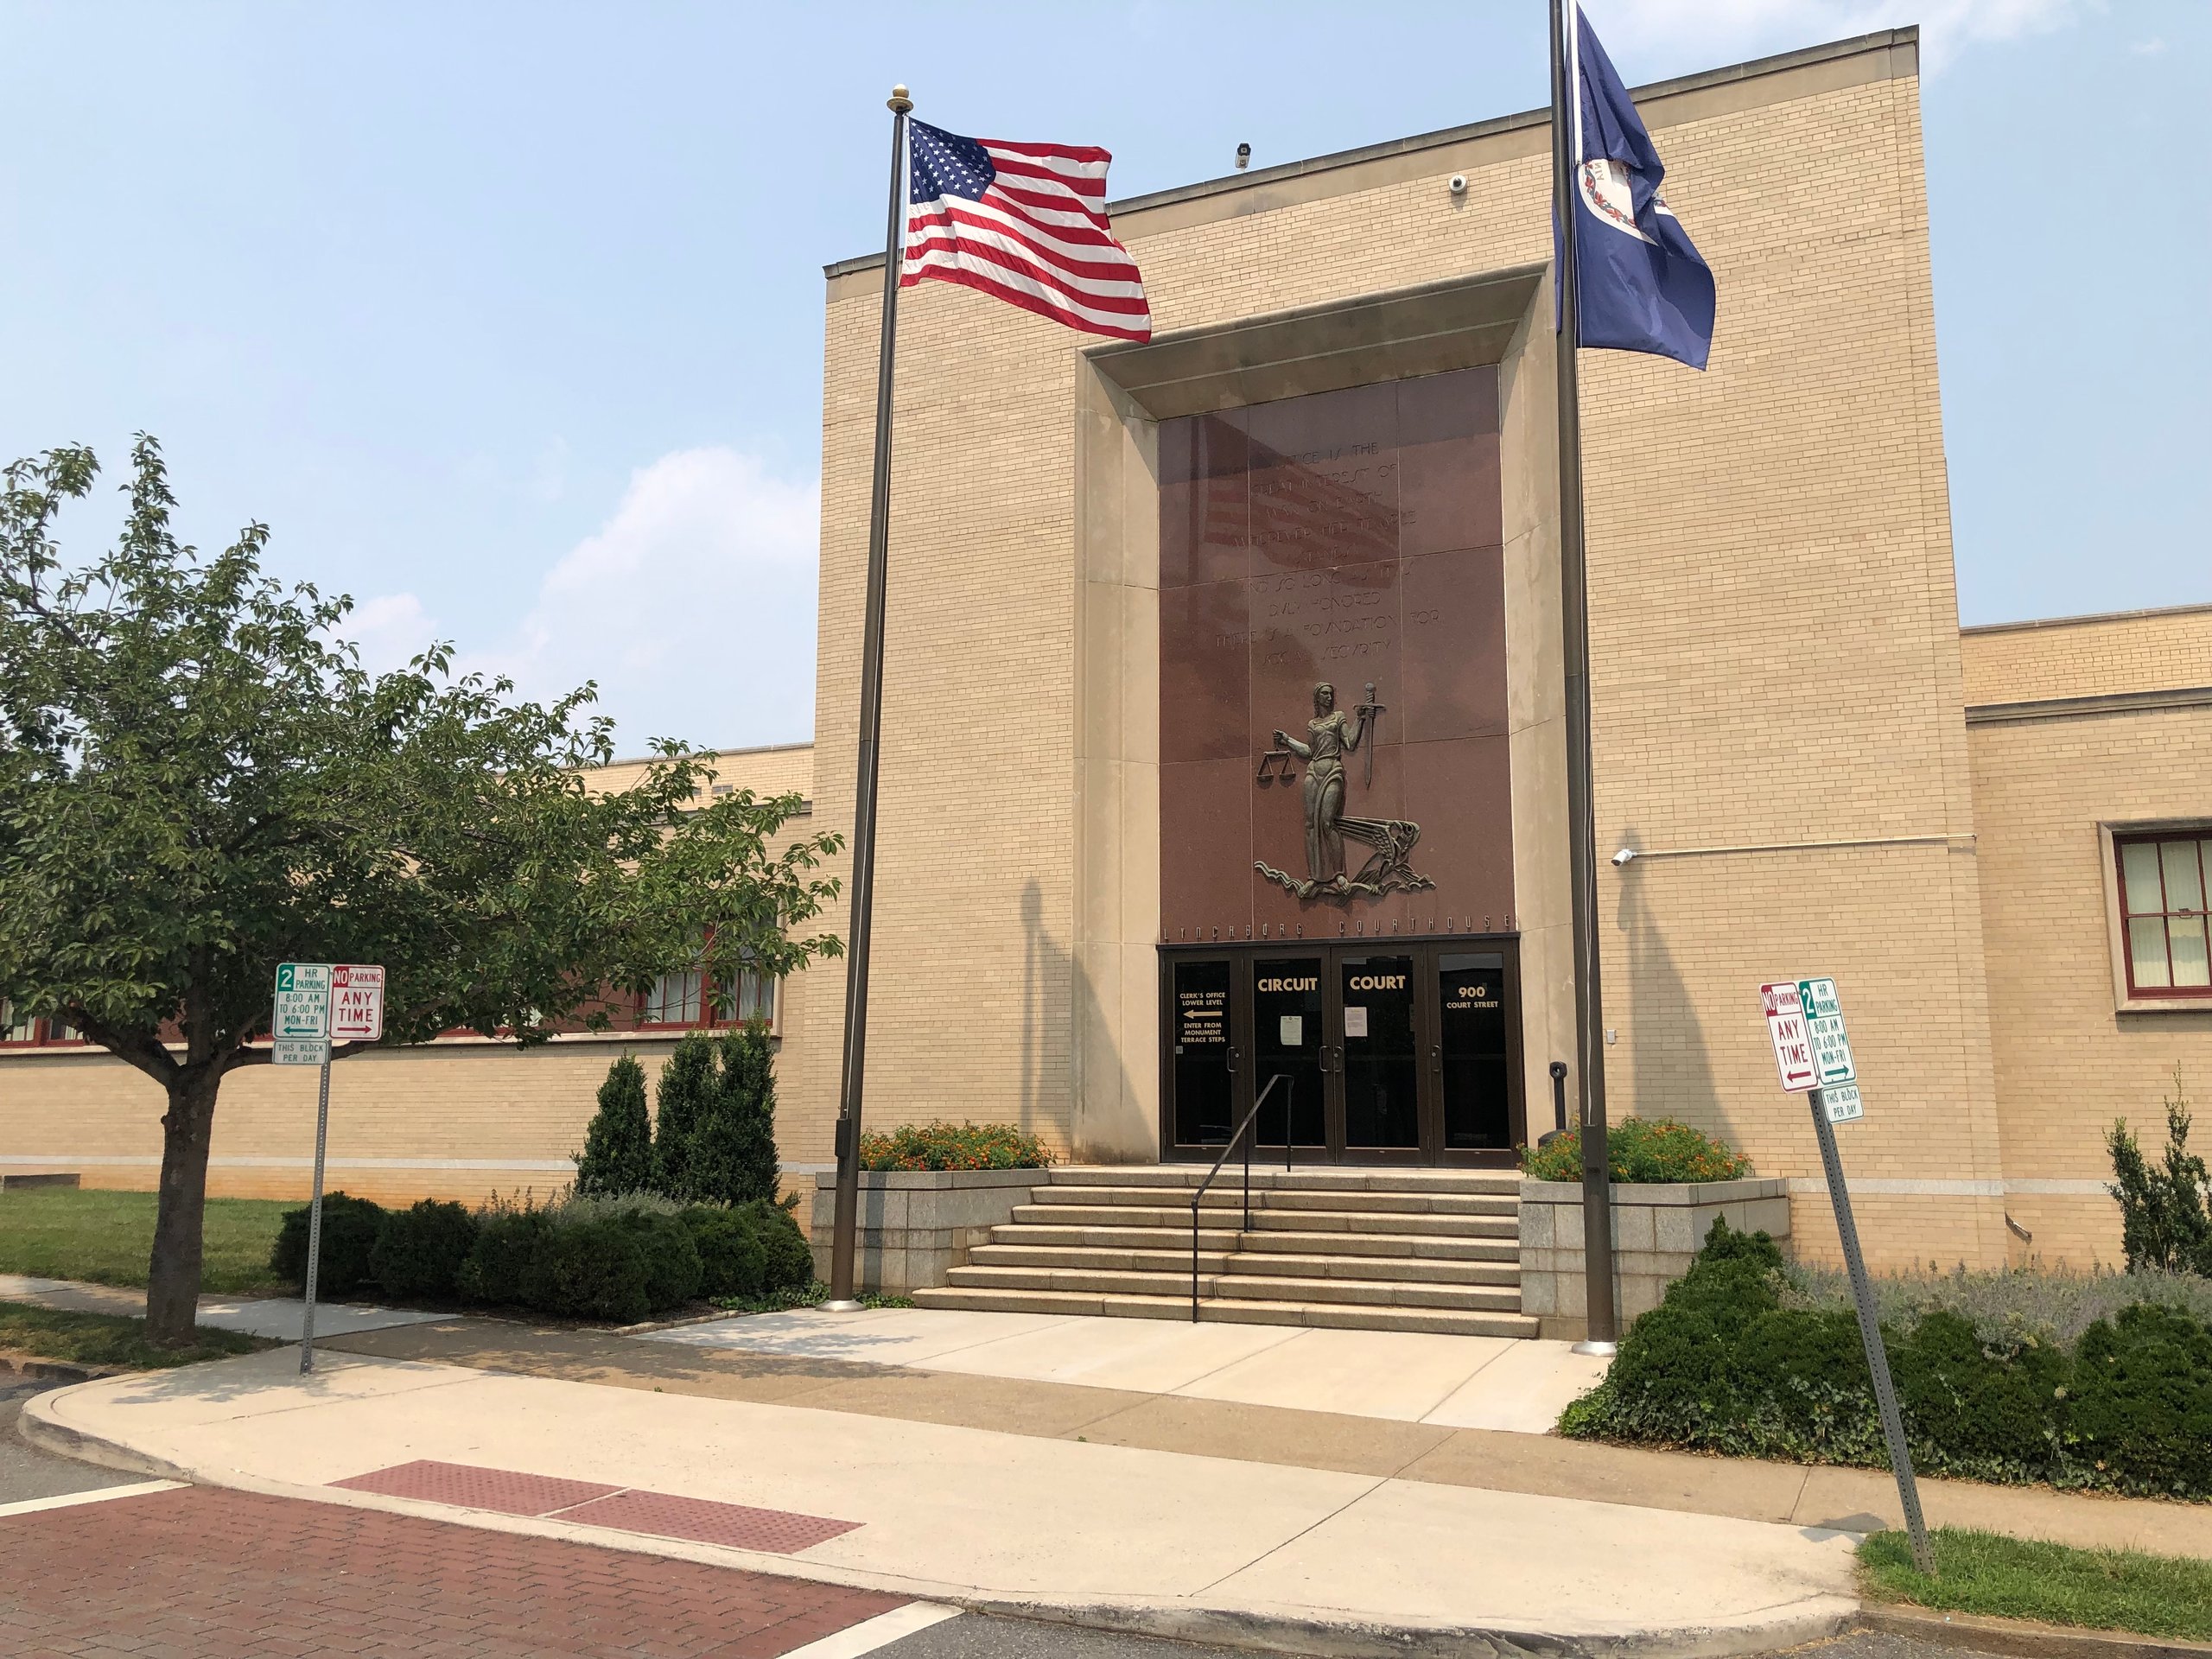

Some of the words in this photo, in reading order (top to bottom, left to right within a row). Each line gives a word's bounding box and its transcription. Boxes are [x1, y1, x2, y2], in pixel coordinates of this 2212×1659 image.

[1352, 442, 1379, 456] THE
[1377, 463, 1397, 478] OF
[1338, 914, 1510, 934] COURTHOUSE
[280, 969, 293, 988] 2
[304, 969, 318, 978] HR
[334, 969, 348, 984] NO
[349, 972, 381, 982] PARKING
[1257, 977, 1318, 992] CIRCUIT
[1350, 976, 1406, 990] COURT
[296, 980, 326, 989] PARKING
[1458, 986, 1485, 998] 900
[285, 993, 302, 1002] 8:00
[308, 994, 320, 1002] AM
[341, 991, 372, 1005] ANY
[1762, 991, 1776, 1012] NO
[1774, 991, 1799, 1007] PARKING
[1802, 988, 1815, 1014] 2
[1817, 983, 1827, 997] HR
[279, 1004, 288, 1014] TO
[292, 1004, 310, 1014] 6:00
[314, 1005, 325, 1014] PM
[1815, 999, 1838, 1014] PARKING
[284, 1015, 318, 1025] MON-FRI
[339, 1008, 373, 1022] TIME
[1777, 1020, 1800, 1041] ANY
[1815, 1020, 1828, 1034] 8:00
[1830, 1019, 1840, 1032] AM
[300, 1044, 323, 1052] BLOCK
[1814, 1037, 1821, 1051] TO
[1823, 1034, 1837, 1050] 6:00
[1837, 1033, 1847, 1046] PM
[1780, 1043, 1808, 1066] TIME
[1821, 1049, 1847, 1065] MON-FRI
[1826, 1090, 1840, 1103] THIS
[1841, 1087, 1859, 1103] BLOCK
[1833, 1106, 1846, 1117] PER
[1847, 1103, 1857, 1115] DAY
